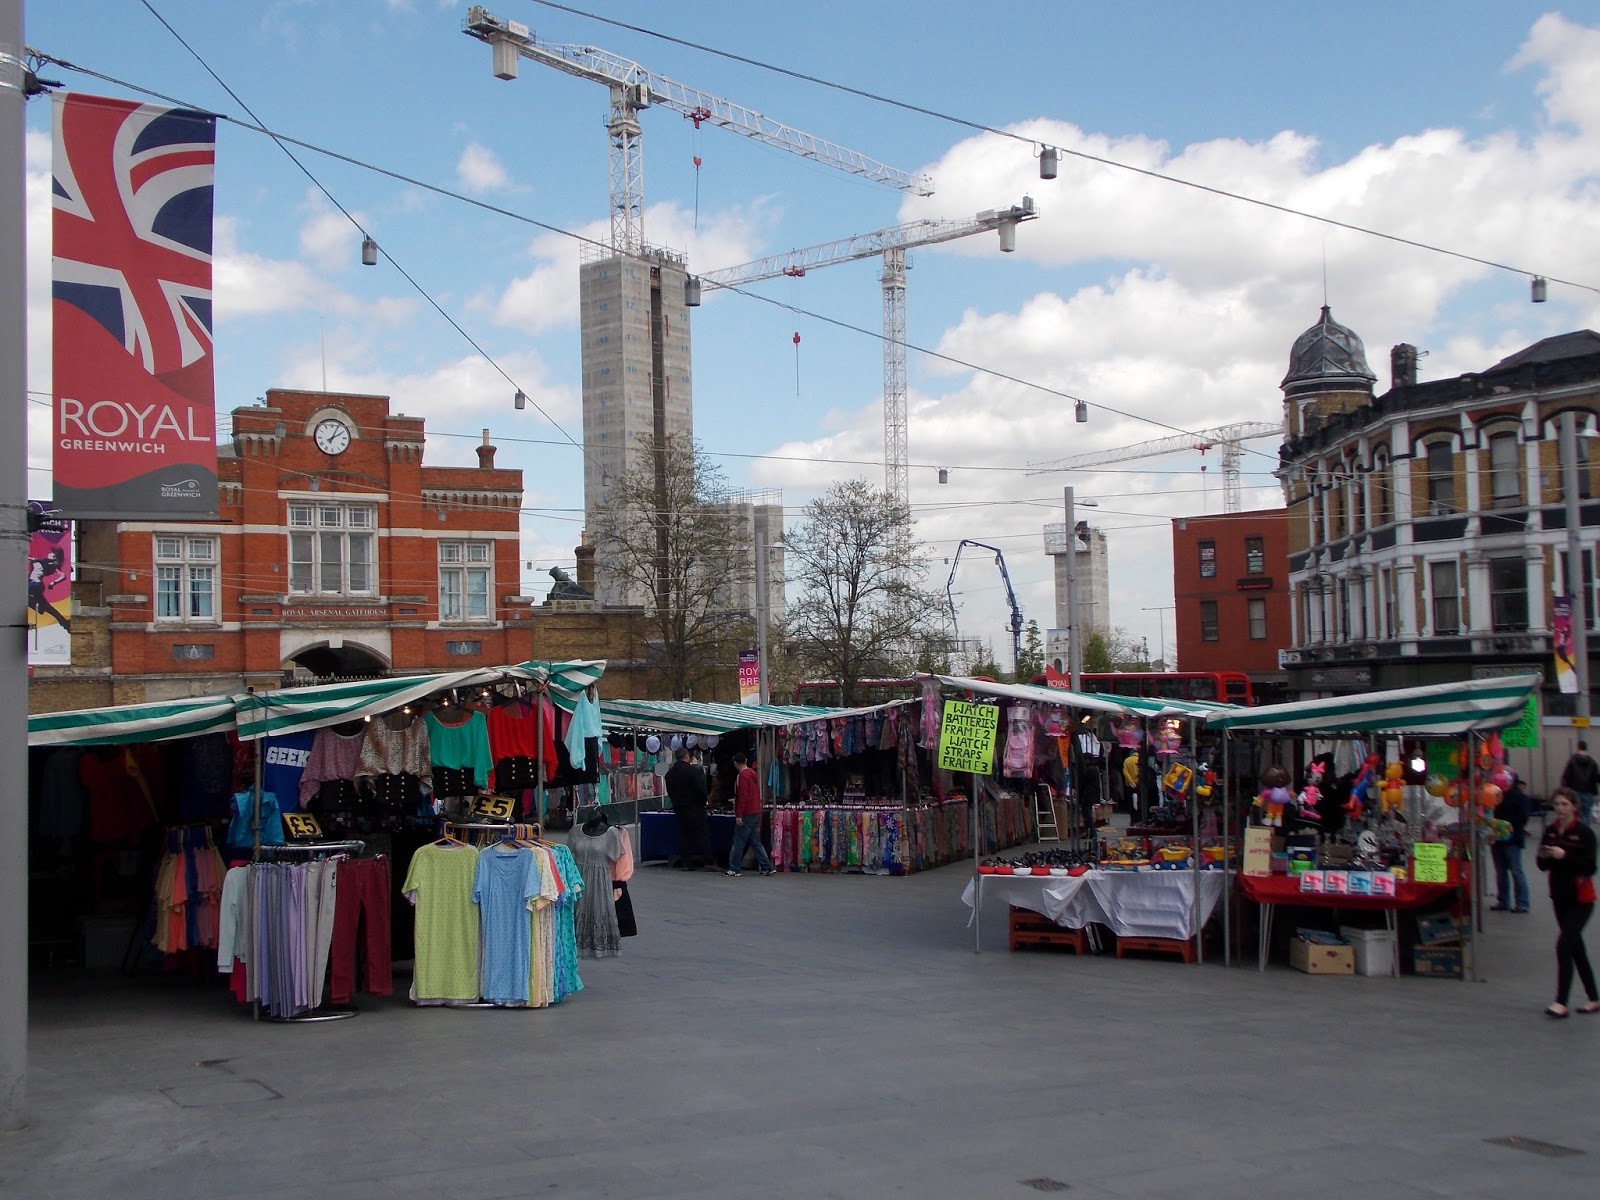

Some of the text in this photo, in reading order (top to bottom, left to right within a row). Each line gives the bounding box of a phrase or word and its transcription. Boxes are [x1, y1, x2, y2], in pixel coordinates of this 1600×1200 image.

[60, 397, 211, 442] ROYAL
[60, 438, 165, 454] GREENWICH
[345, 608, 389, 616] GATEHOUSE
[1047, 679, 1069, 688] ROYAL
[953, 702, 994, 718] WATCH
[946, 713, 996, 729] BATTERIES
[949, 735, 989, 750] WATCH
[266, 746, 311, 768] GEEK
[944, 746, 982, 760] STRAPS
[473, 796, 508, 816] £5
[289, 816, 317, 835] £5
